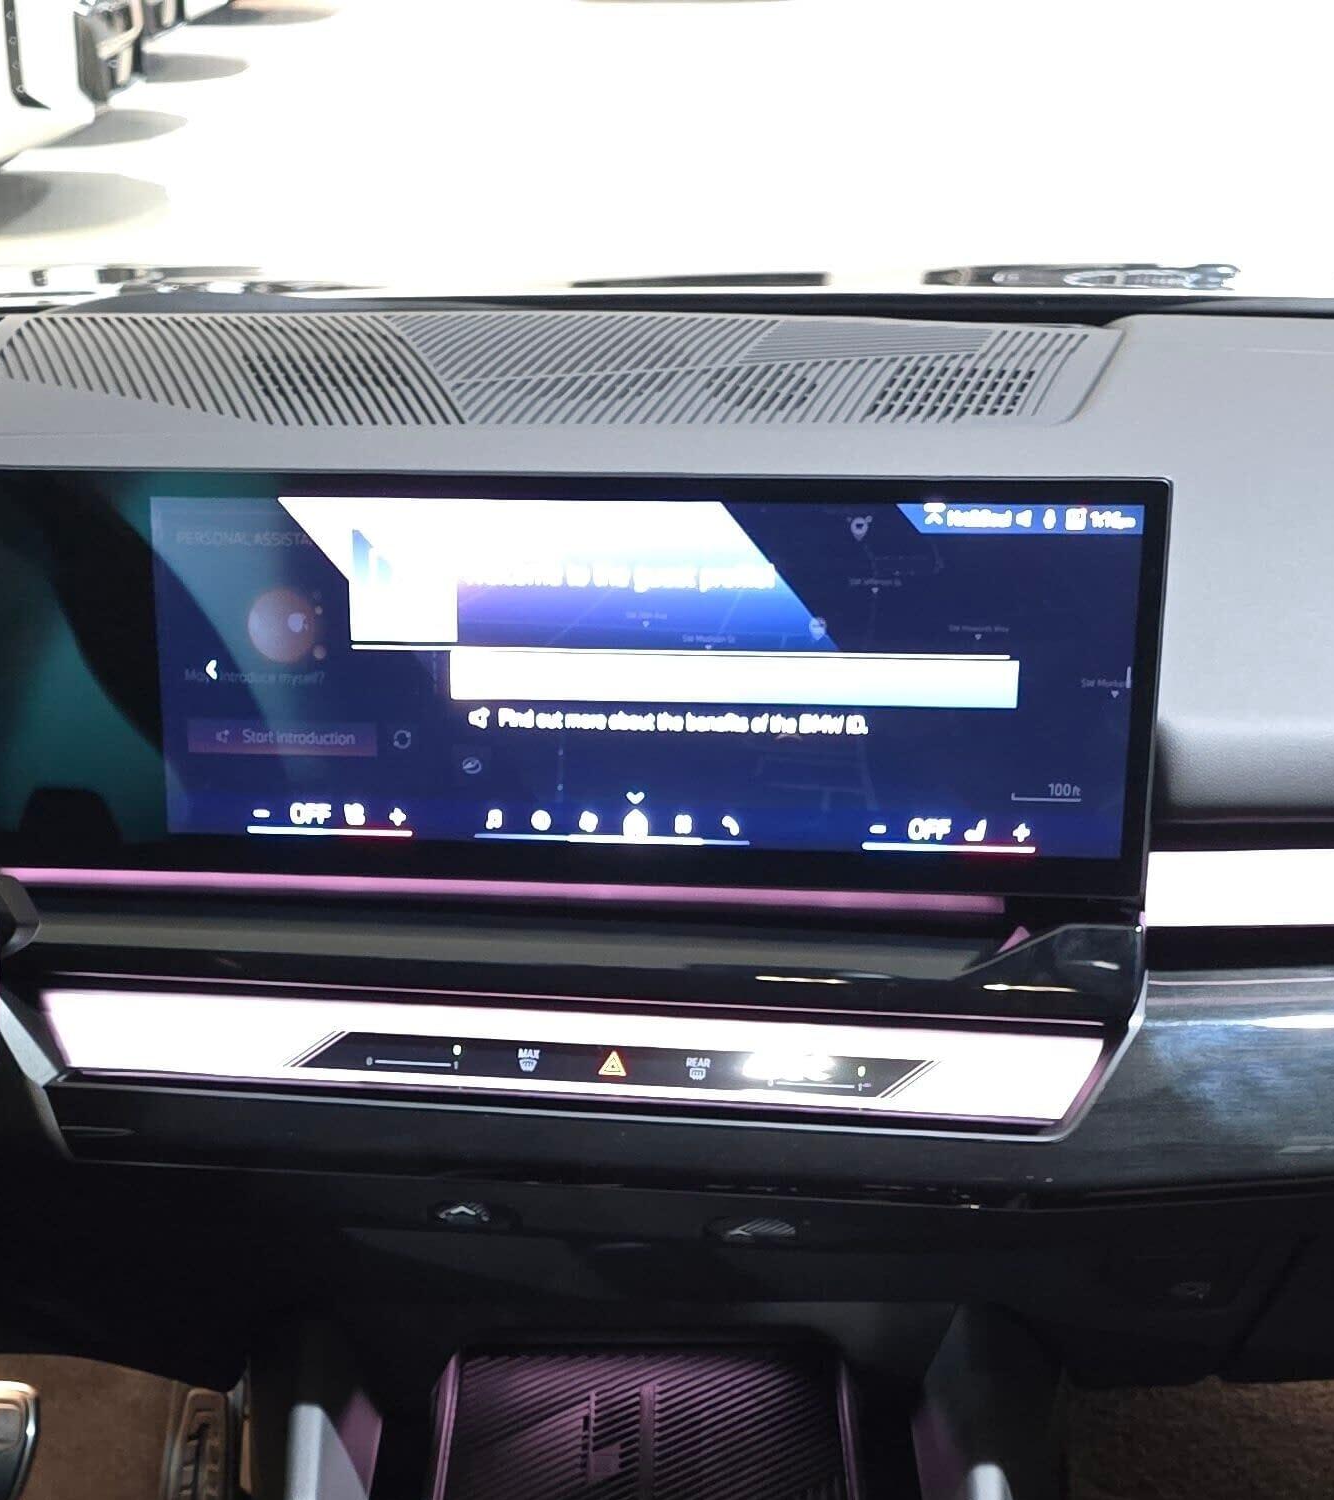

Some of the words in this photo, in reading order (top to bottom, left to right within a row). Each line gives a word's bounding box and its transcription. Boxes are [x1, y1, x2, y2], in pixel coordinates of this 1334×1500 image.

[256, 531, 317, 546] ASSISTA
[498, 708, 534, 727] Find
[536, 711, 563, 729] out
[565, 713, 606, 730] more
[608, 711, 655, 731] about
[657, 712, 684, 732] the
[685, 712, 749, 732] benefits
[751, 713, 769, 733] of
[770, 714, 797, 734] the
[799, 714, 844, 734] BMW
[242, 728, 274, 744] Start
[276, 729, 356, 746] introduction
[1048, 783, 1071, 796] 100
[289, 802, 332, 824] OFF
[908, 817, 952, 840] OFF
[518, 1048, 540, 1060] MAX
[685, 1057, 711, 1068] REAR
